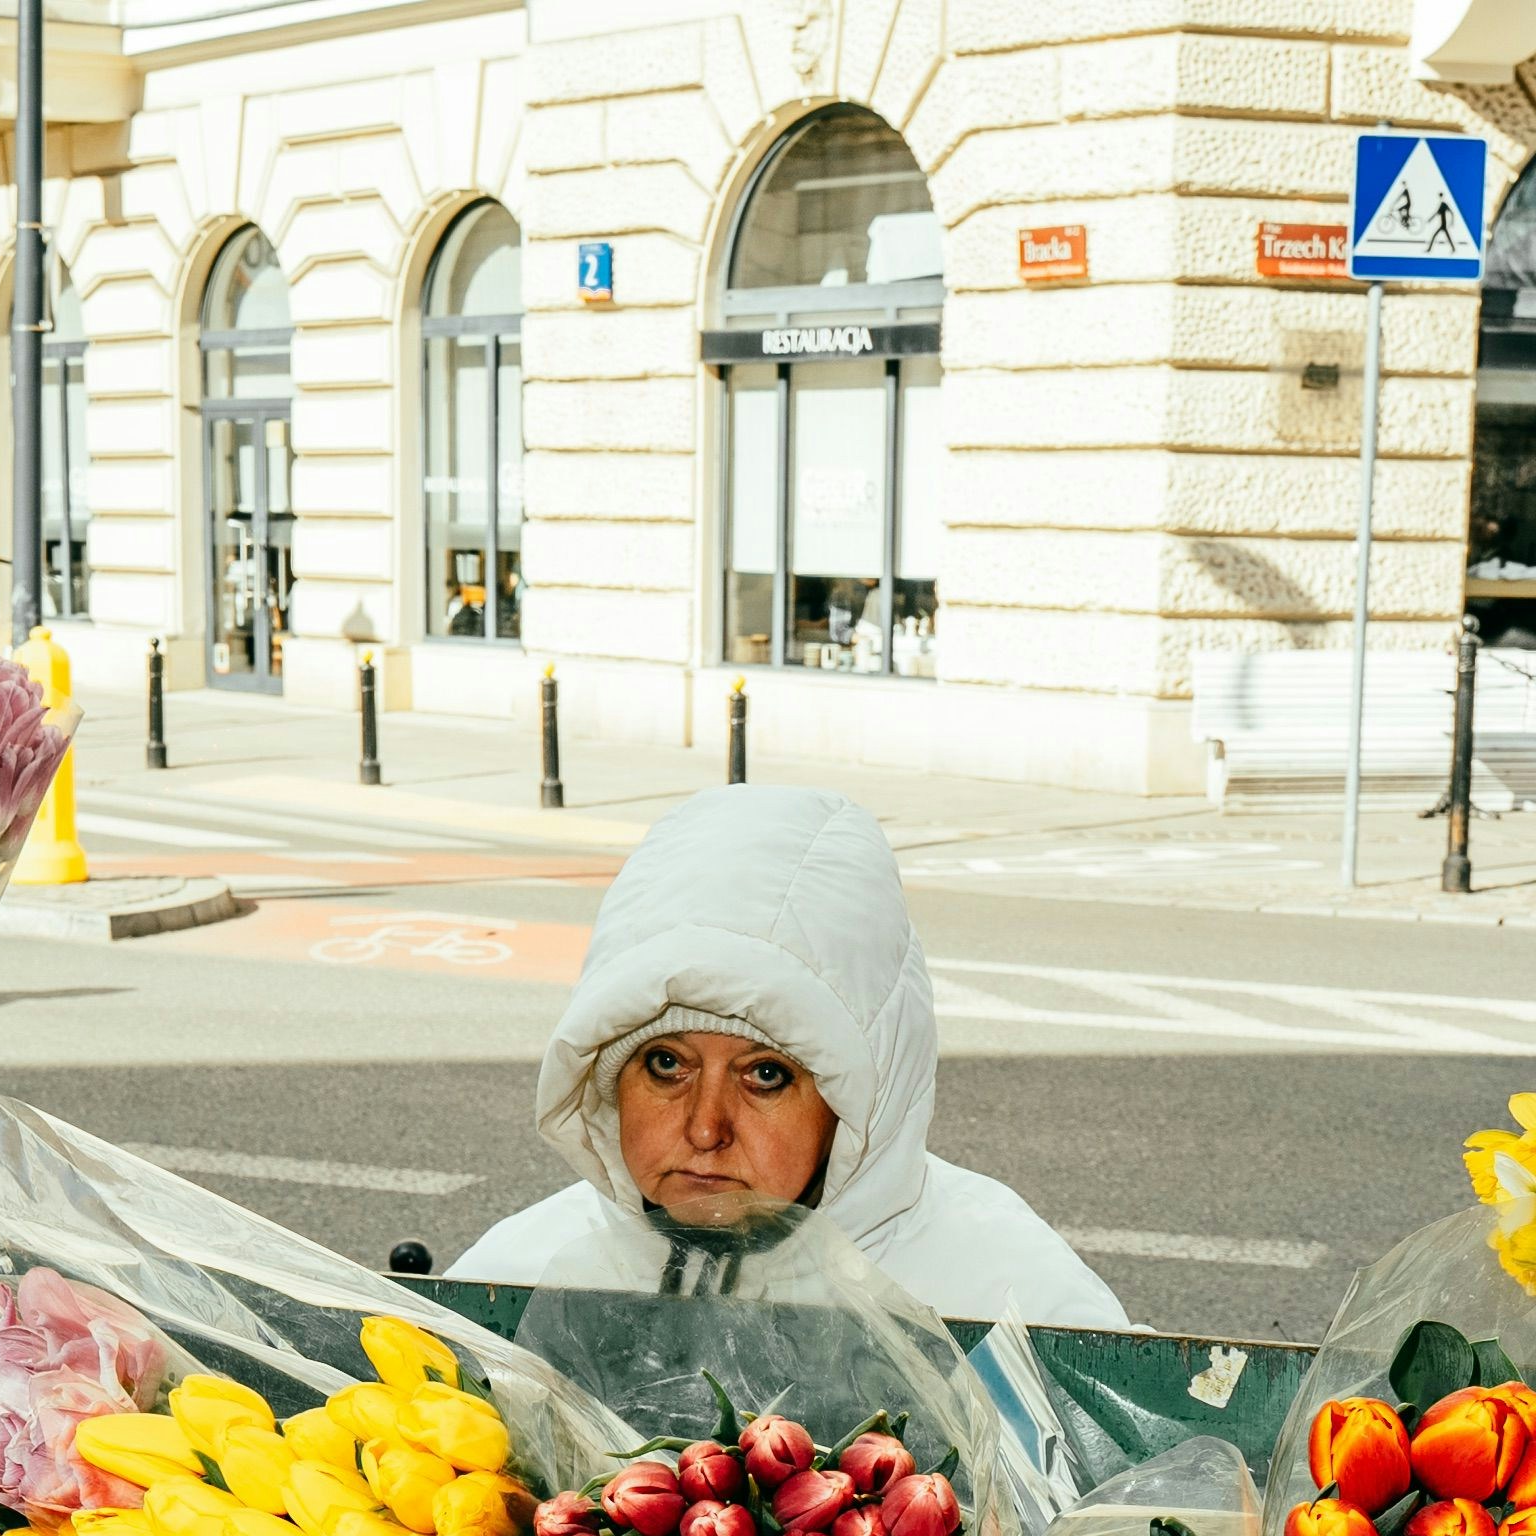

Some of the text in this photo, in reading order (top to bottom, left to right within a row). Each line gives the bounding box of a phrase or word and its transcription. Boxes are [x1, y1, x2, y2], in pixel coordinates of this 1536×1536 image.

[1261, 232, 1327, 259] Trzech
[585, 254, 599, 286] 2
[762, 326, 873, 356] RESTAURACJA
